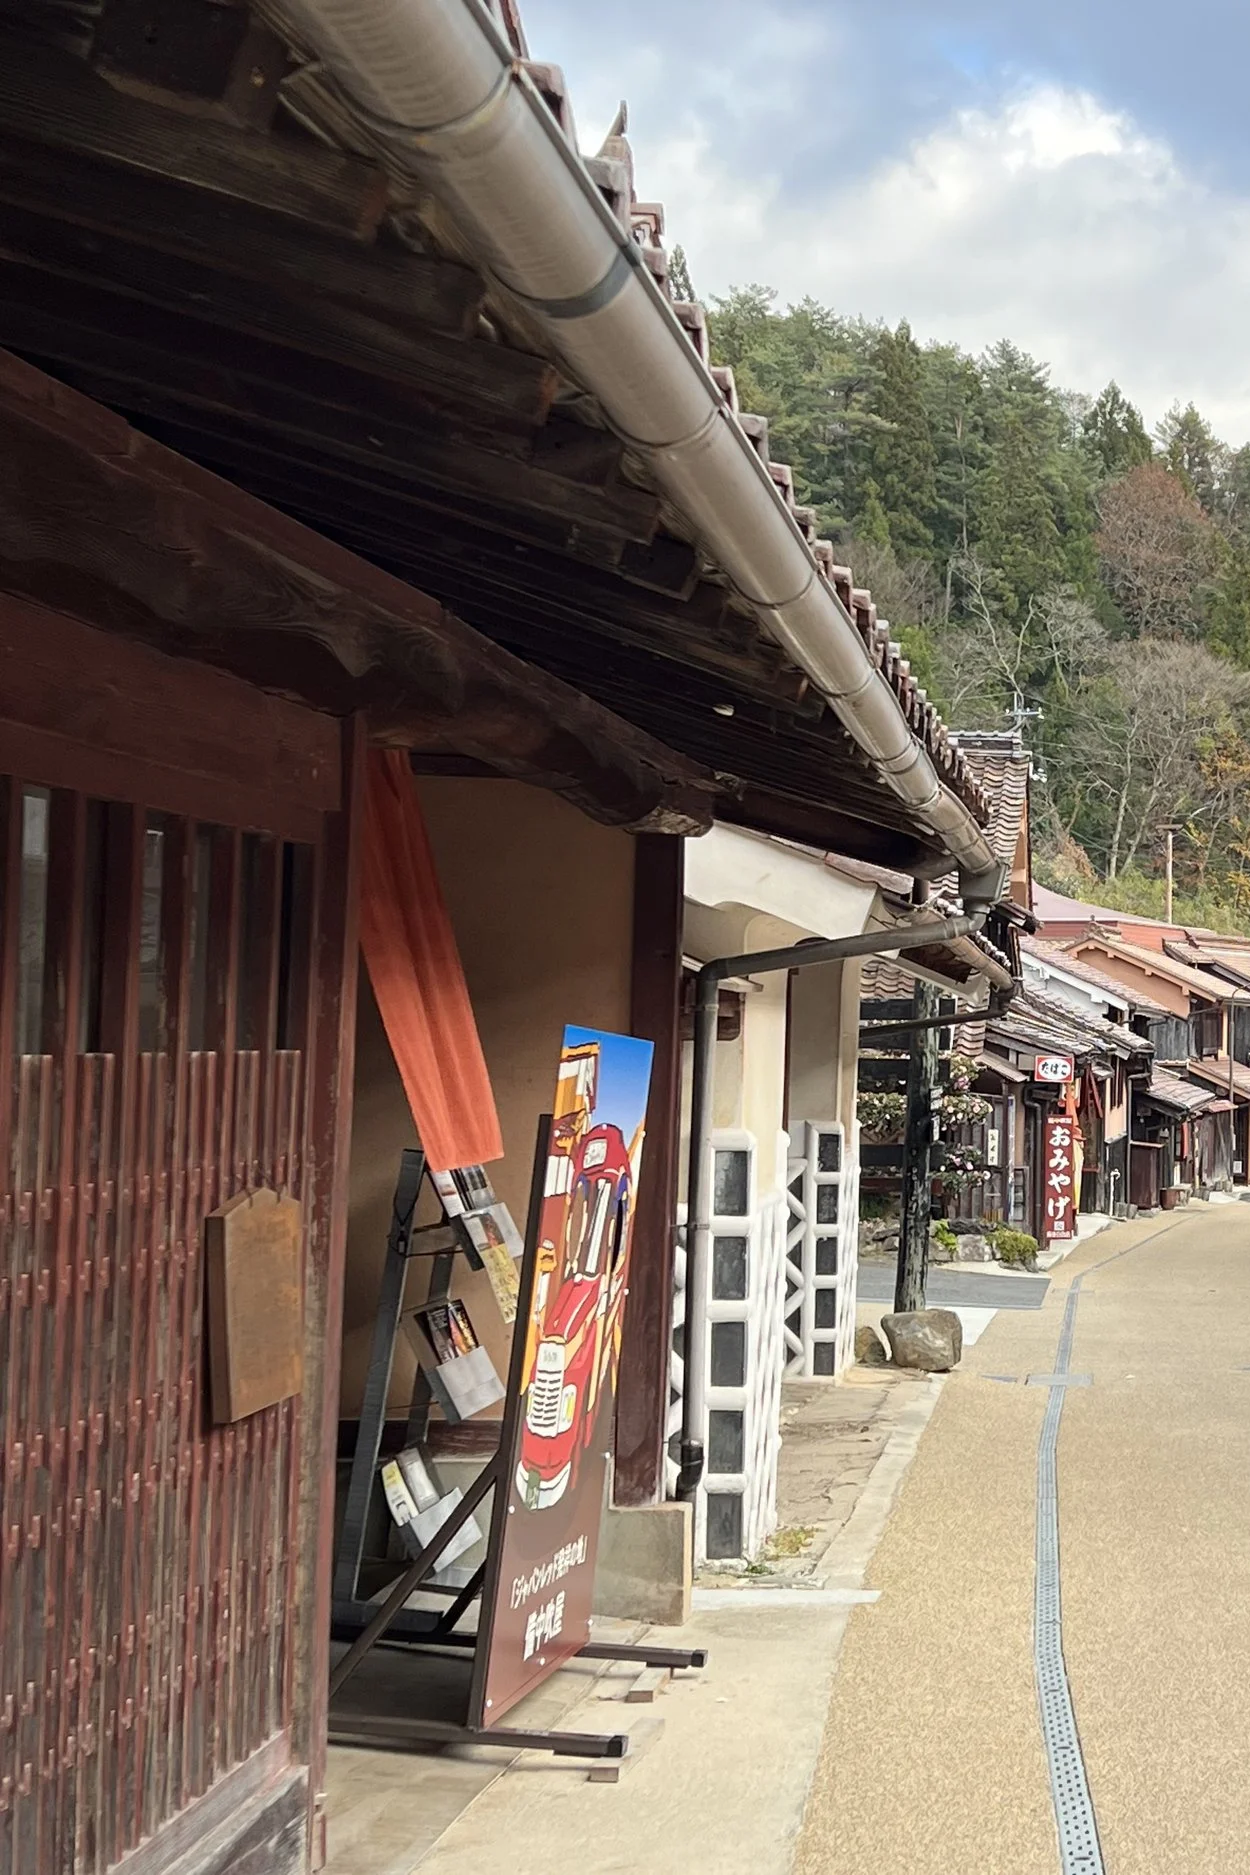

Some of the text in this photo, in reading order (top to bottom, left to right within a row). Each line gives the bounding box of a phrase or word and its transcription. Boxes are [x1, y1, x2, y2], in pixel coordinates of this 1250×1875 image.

[1048, 1125, 1071, 1220] おみやげ
[523, 1590, 566, 1662] 備中吹屋
